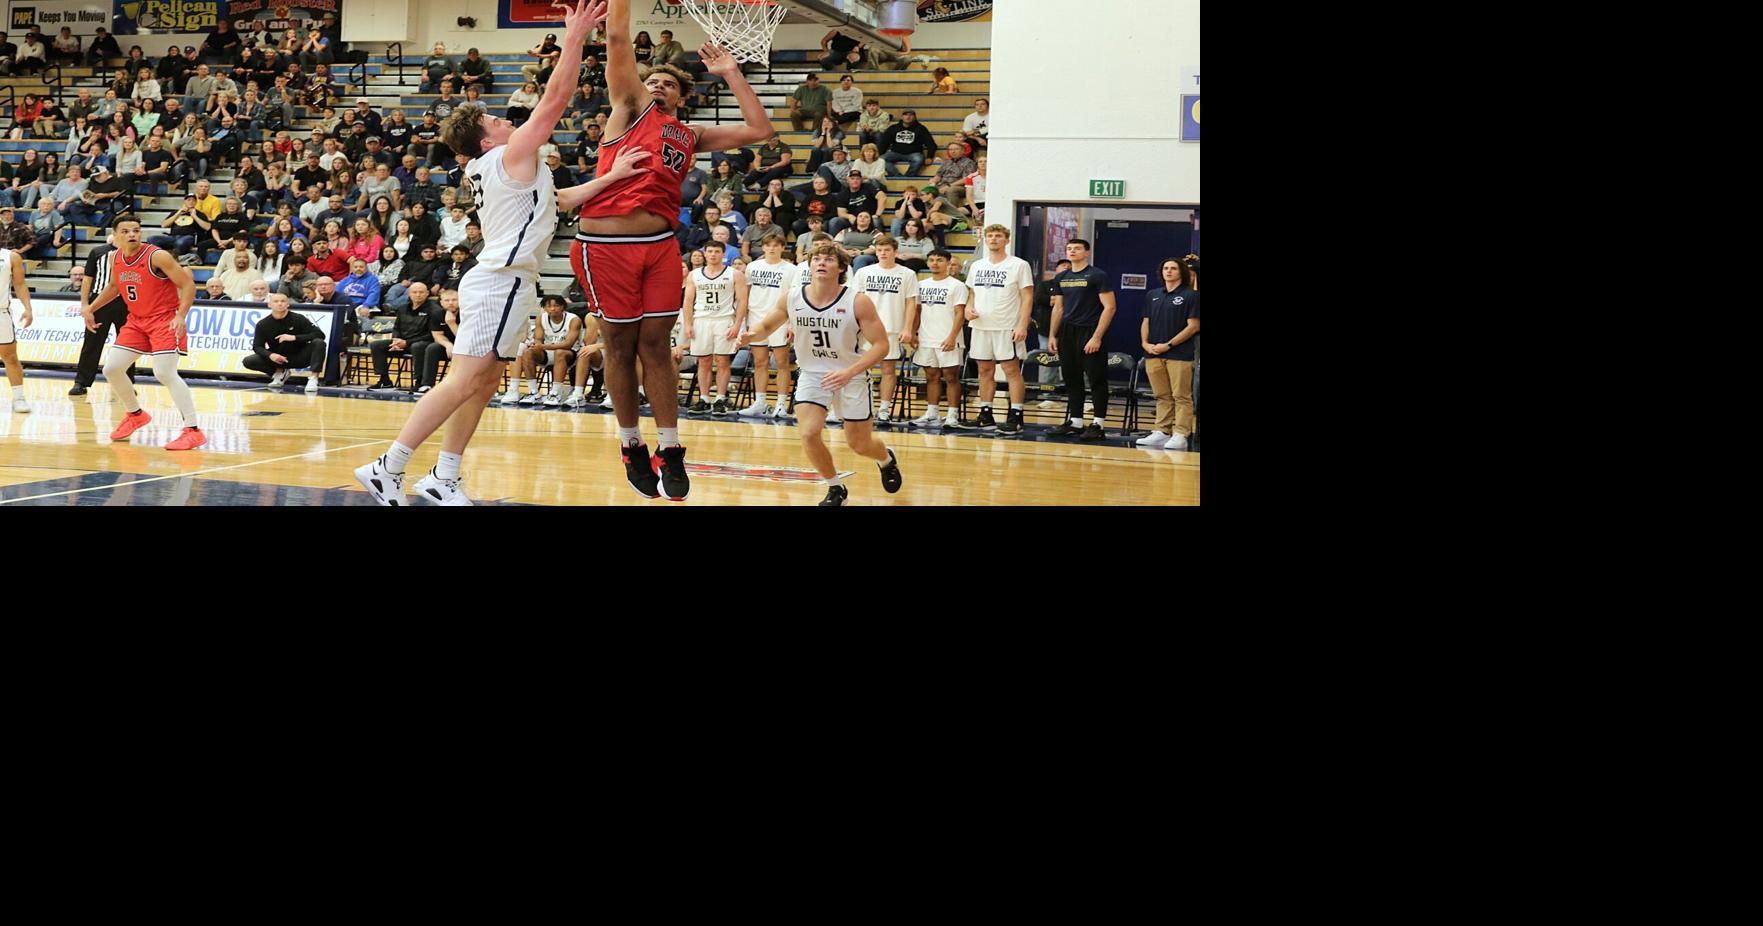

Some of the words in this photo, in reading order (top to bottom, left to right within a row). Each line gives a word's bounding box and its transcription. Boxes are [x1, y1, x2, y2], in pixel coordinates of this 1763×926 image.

[146, 0, 217, 15] Pelican
[39, 11, 61, 24] Keeps
[63, 11, 76, 22] You
[78, 10, 105, 23] Moving
[159, 12, 217, 31] Sign
[1094, 181, 1121, 196] EXIT
[751, 270, 783, 280] ALWAYS
[866, 275, 902, 286] ALWAYS
[976, 269, 1007, 279] ALWAYS
[126, 285, 137, 301] 5
[706, 291, 719, 304] 21
[229, 310, 262, 337] US
[43, 330, 71, 342] TECH
[810, 330, 831, 348] 31
[812, 349, 838, 359] OWLS
